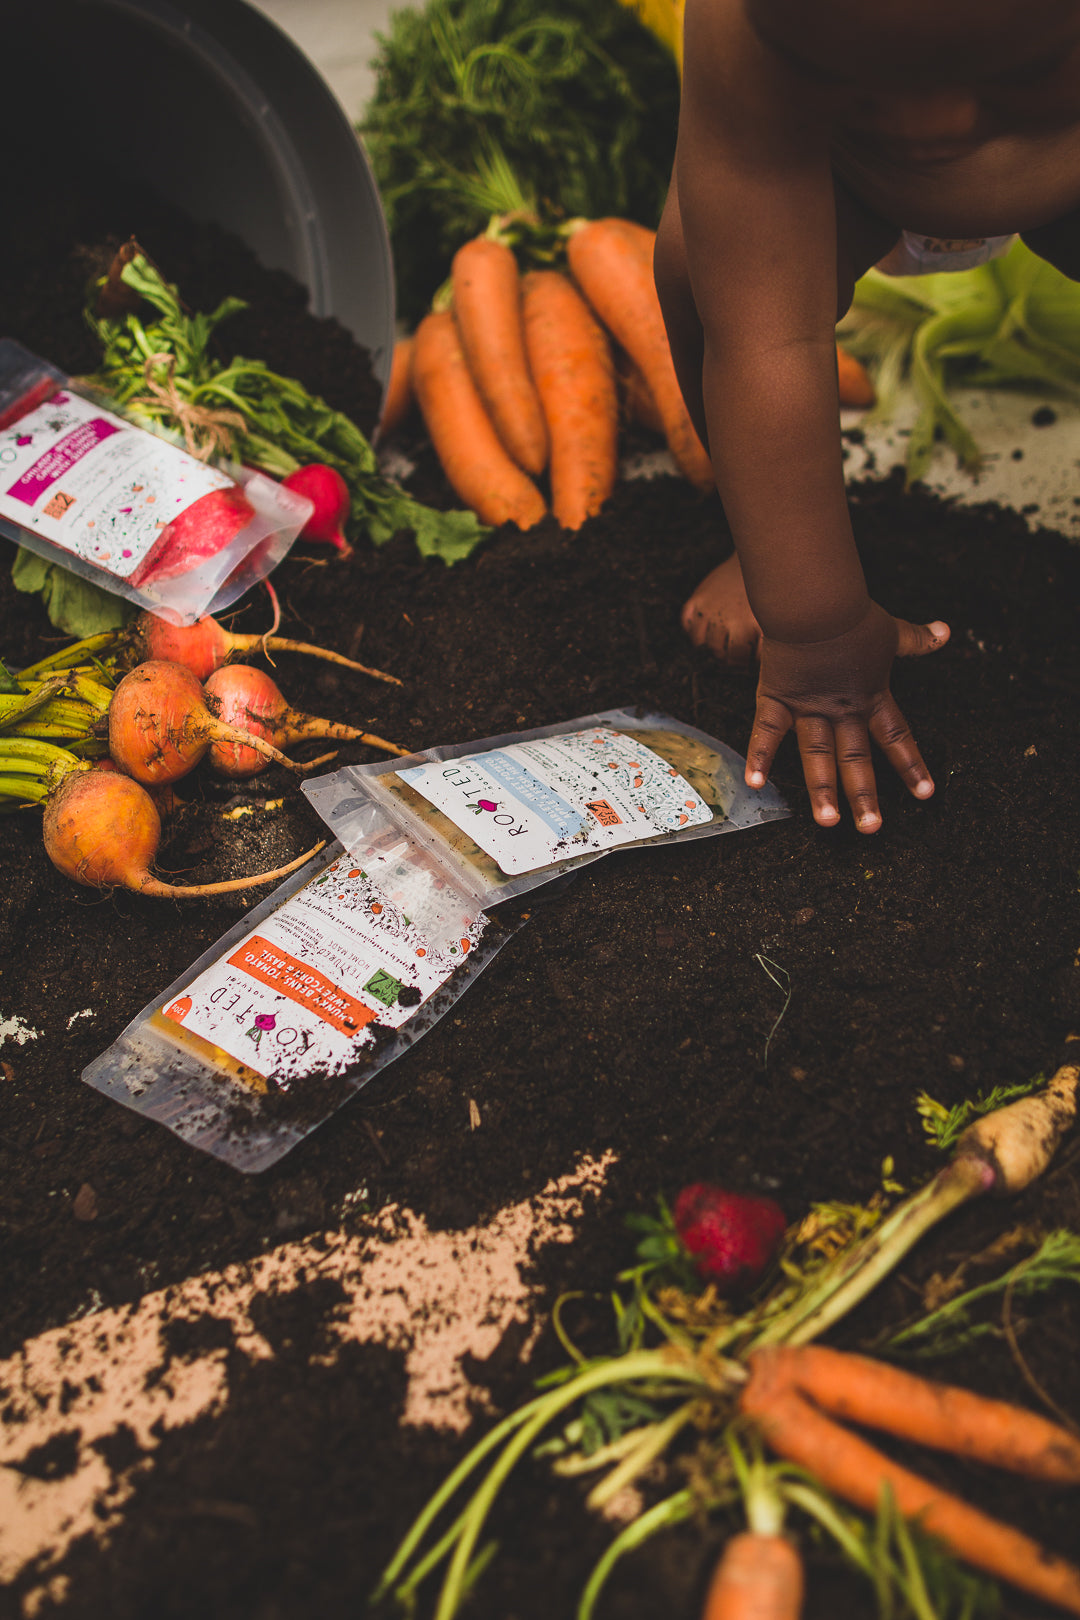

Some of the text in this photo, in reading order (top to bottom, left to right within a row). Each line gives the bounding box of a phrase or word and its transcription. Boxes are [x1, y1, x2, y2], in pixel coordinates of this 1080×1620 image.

[53, 489, 74, 508] 2
[509, 779, 538, 801] SWEET
[515, 774, 542, 794] FRESH
[544, 797, 571, 818] APPLE
[327, 939, 348, 955] MADE
[355, 930, 384, 952] Professional
[242, 951, 281, 978] TOMATO,
[316, 946, 362, 979] TEXTURED
[347, 952, 370, 969] HOME
[225, 975, 264, 999] natural
[259, 949, 350, 1009] SWEETCORN & BASIL
[280, 974, 314, 998] BEANS,
[365, 971, 389, 994] 2
[171, 1003, 185, 1015] 120g
